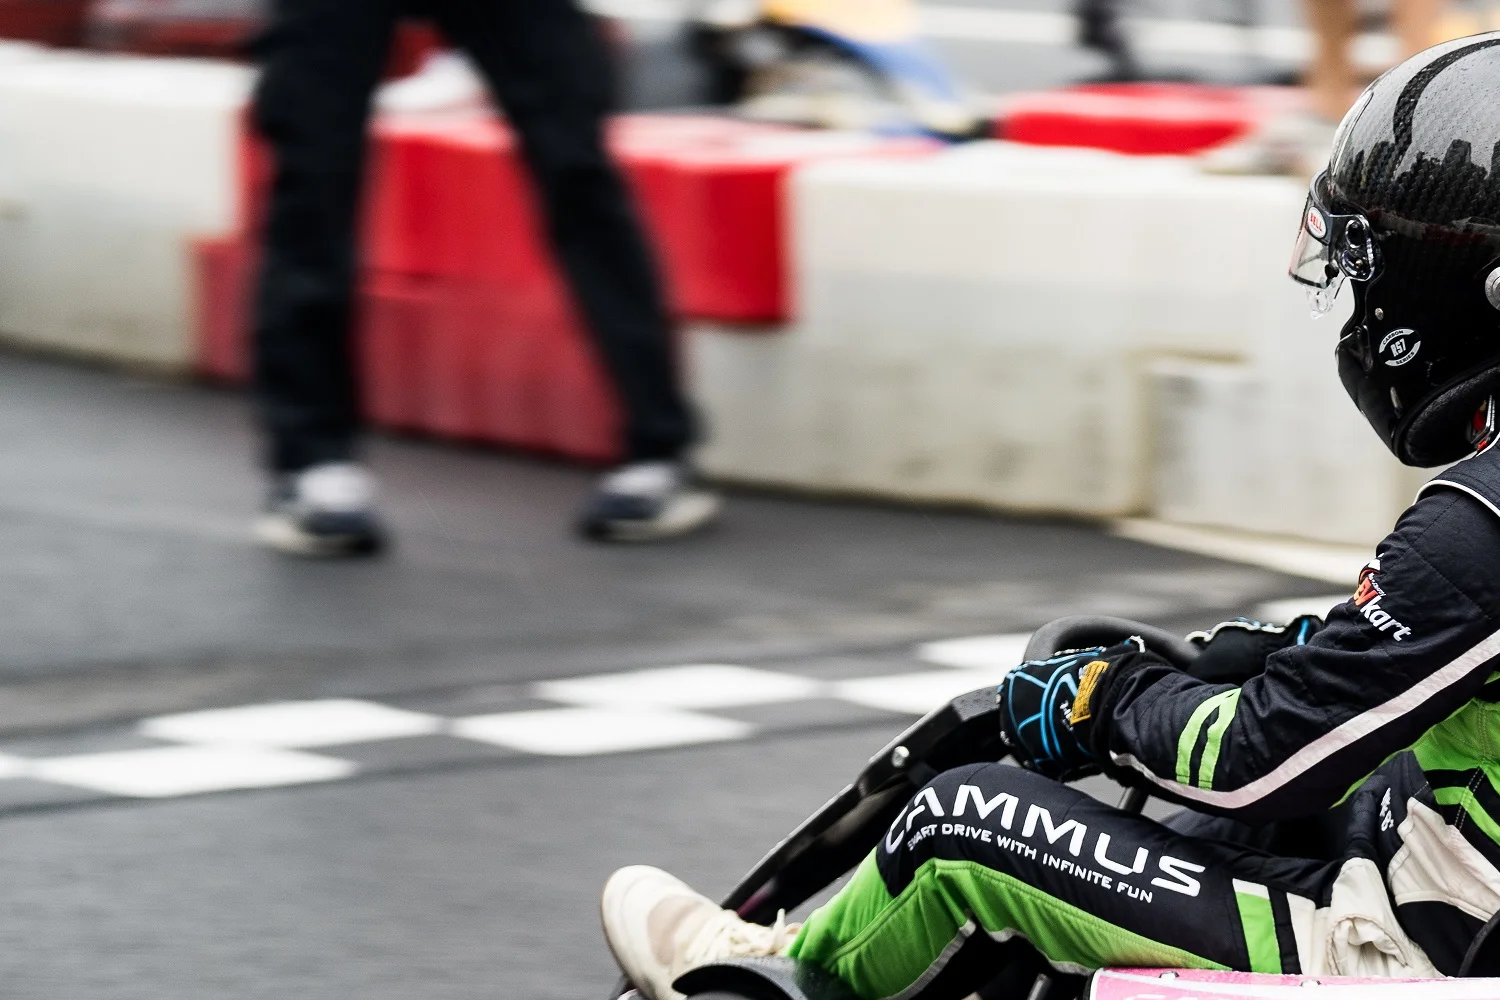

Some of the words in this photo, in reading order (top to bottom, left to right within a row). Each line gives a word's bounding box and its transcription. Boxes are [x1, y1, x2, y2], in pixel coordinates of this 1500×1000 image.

[1382, 330, 1404, 345] CARBON
[1390, 338, 1407, 357] RS7
[1396, 352, 1415, 365] SERIES
[885, 784, 1206, 897] CAMMUS
[907, 824, 938, 852] SMART
[941, 823, 993, 843] DRIVE
[996, 834, 1038, 861] WITH
[1042, 852, 1113, 890] INFINITE
[1116, 881, 1153, 904] FUN
